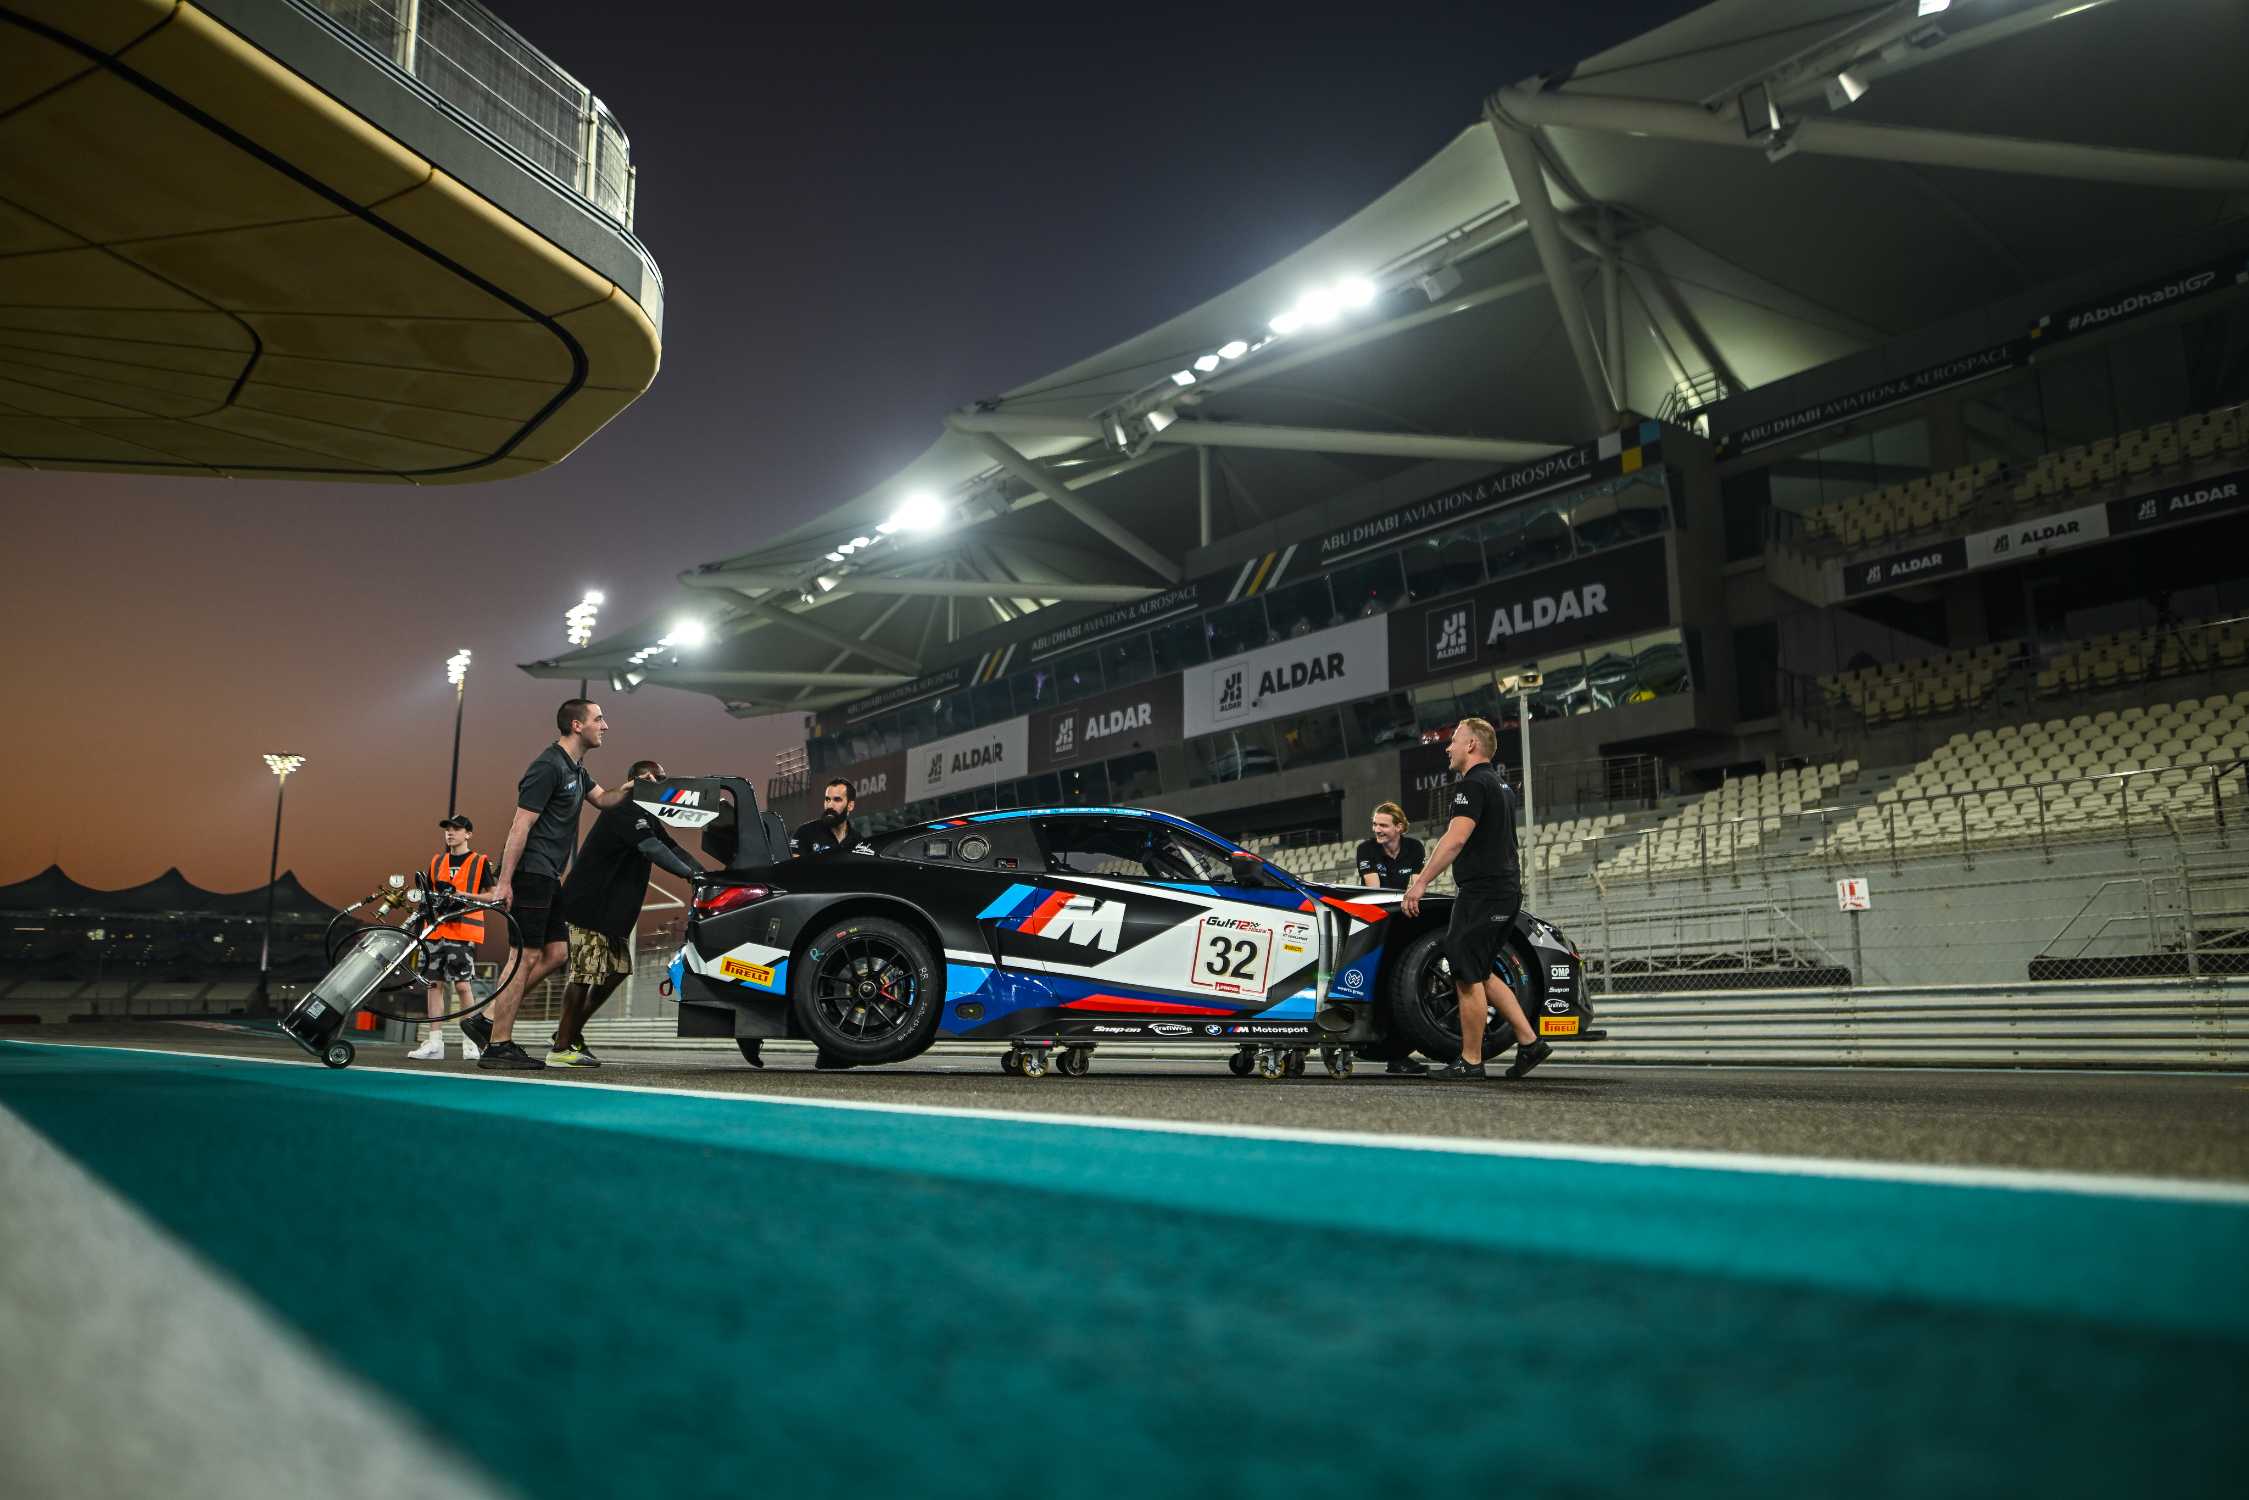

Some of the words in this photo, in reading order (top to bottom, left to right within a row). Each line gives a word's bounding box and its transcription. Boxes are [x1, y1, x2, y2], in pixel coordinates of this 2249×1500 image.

[1741, 426, 1772, 444] ABU
[1773, 406, 1822, 437] DHABI
[1822, 383, 1900, 418] AVIATION
[1899, 380, 1911, 394] &
[1913, 346, 2011, 388] AEROSPACE
[1321, 532, 1352, 553] ABU
[1352, 513, 1400, 543] DHABI
[1403, 491, 1474, 523] AVIATION
[1475, 485, 1487, 501] &
[1490, 449, 1591, 494] AEROSPACE
[2169, 482, 2239, 512] ALDAR
[2020, 520, 2081, 546] ALDAR
[1890, 552, 1943, 577] ALDAR
[1485, 583, 1609, 646] ALDAR
[1437, 645, 1468, 660] ALDAR
[1258, 652, 1345, 697] ALDAR
[1085, 703, 1153, 741] ALDAR
[951, 741, 1004, 774] ALDAR
[853, 773, 887, 798] LDAR
[1416, 772, 1449, 792] LIVE
[658, 806, 709, 822] WRT
[1206, 935, 1259, 981] 32
[724, 960, 770, 983] PIRELLI
[1551, 968, 1570, 977] OMP
[1092, 1025, 1142, 1034] Snap-on
[1252, 1024, 1309, 1035] Motorsport
[1544, 1020, 1577, 1032] PIRELLI
